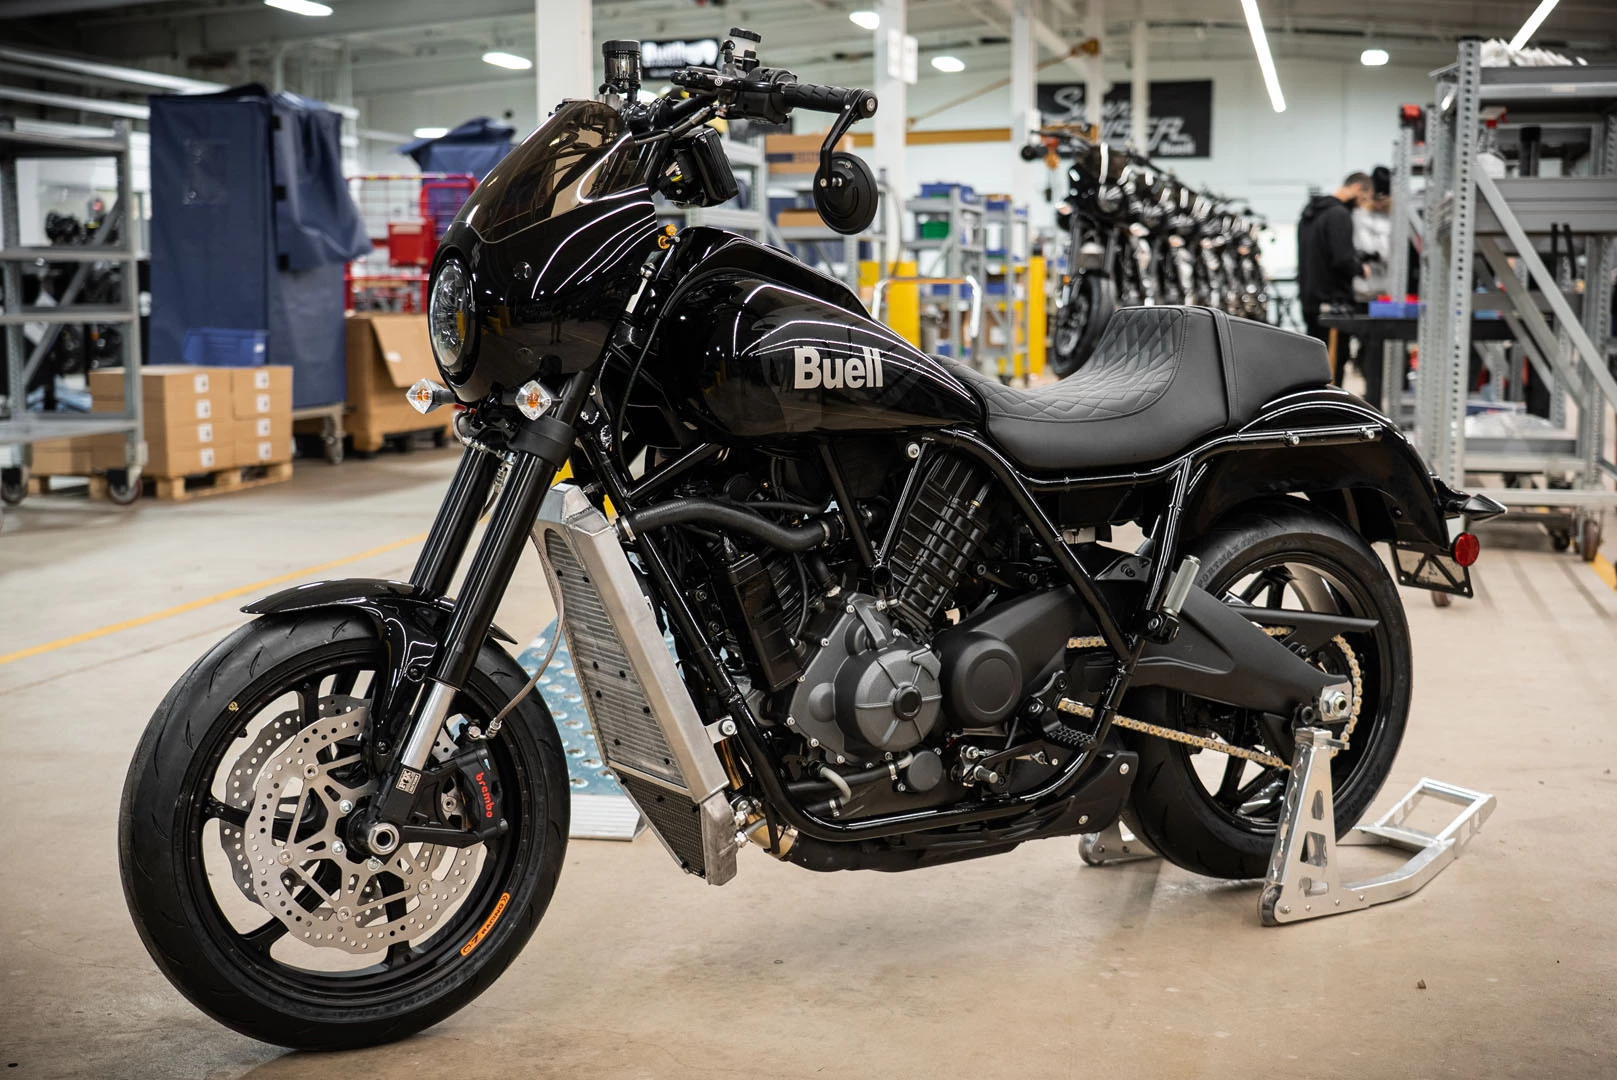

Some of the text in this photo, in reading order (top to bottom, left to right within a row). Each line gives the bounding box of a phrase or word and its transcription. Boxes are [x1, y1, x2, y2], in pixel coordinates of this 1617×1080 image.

[794, 347, 884, 390] Buell
[475, 771, 494, 818] brembo
[481, 903, 504, 935] RACING
